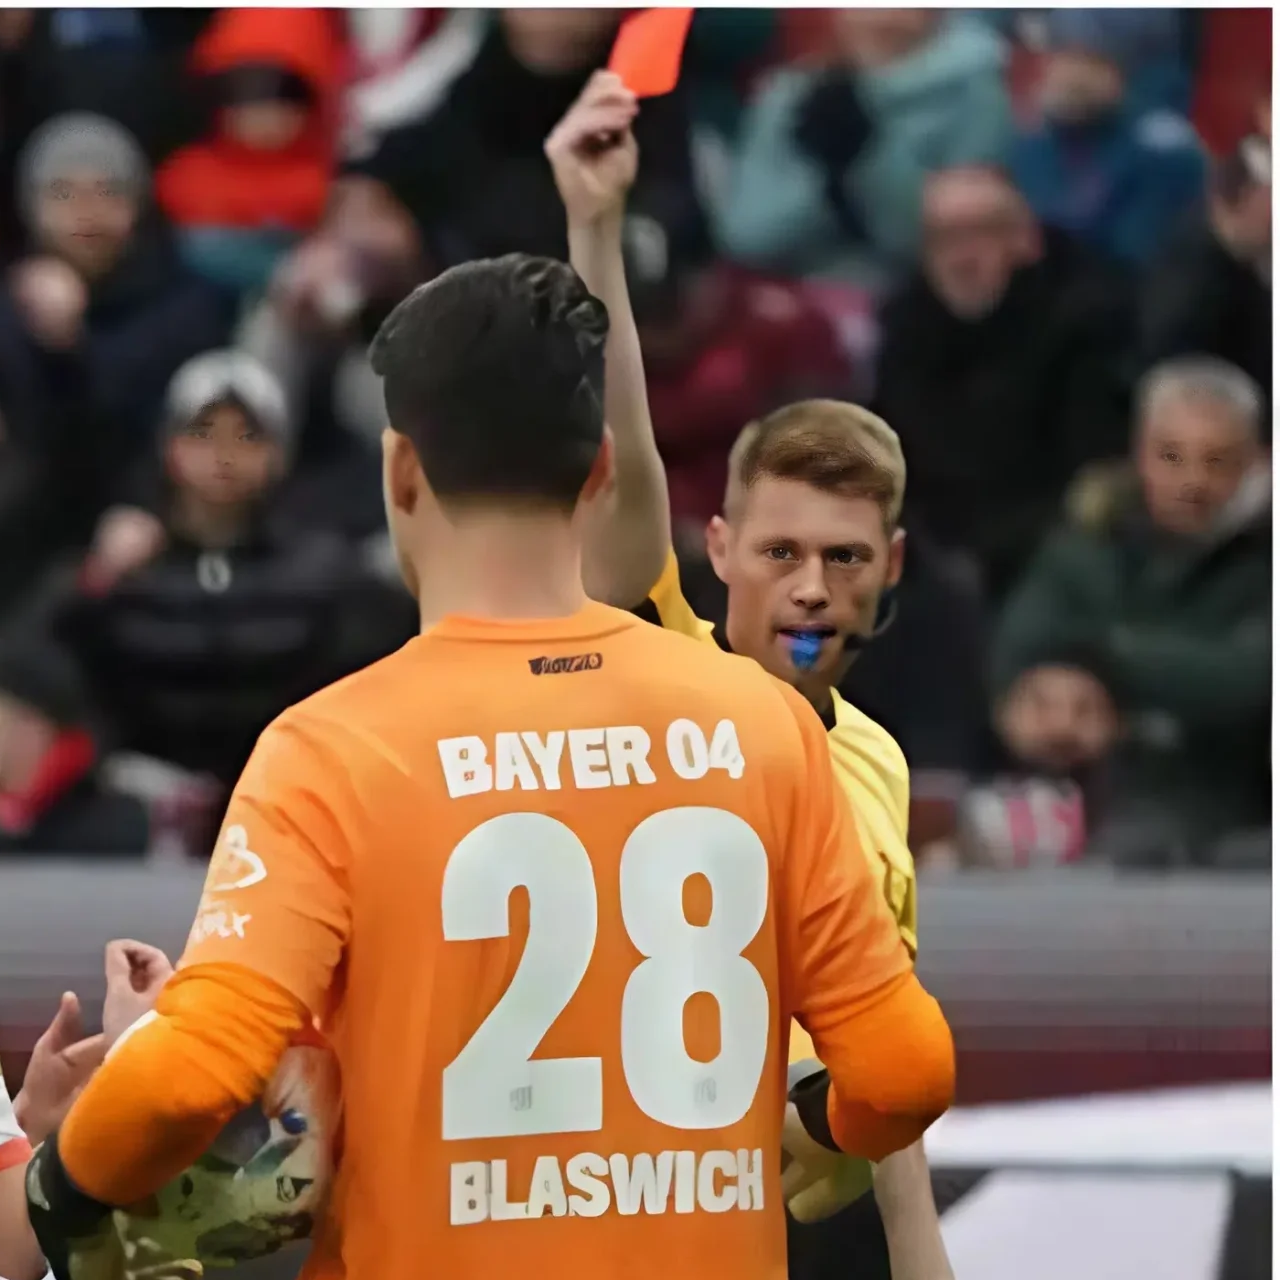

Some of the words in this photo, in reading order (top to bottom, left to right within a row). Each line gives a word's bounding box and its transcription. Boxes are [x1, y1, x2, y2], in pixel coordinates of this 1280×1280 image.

[437, 725, 657, 799] BAYER
[665, 717, 746, 780] 04
[441, 806, 770, 1140] 28
[449, 1148, 765, 1226] BLASWICH
